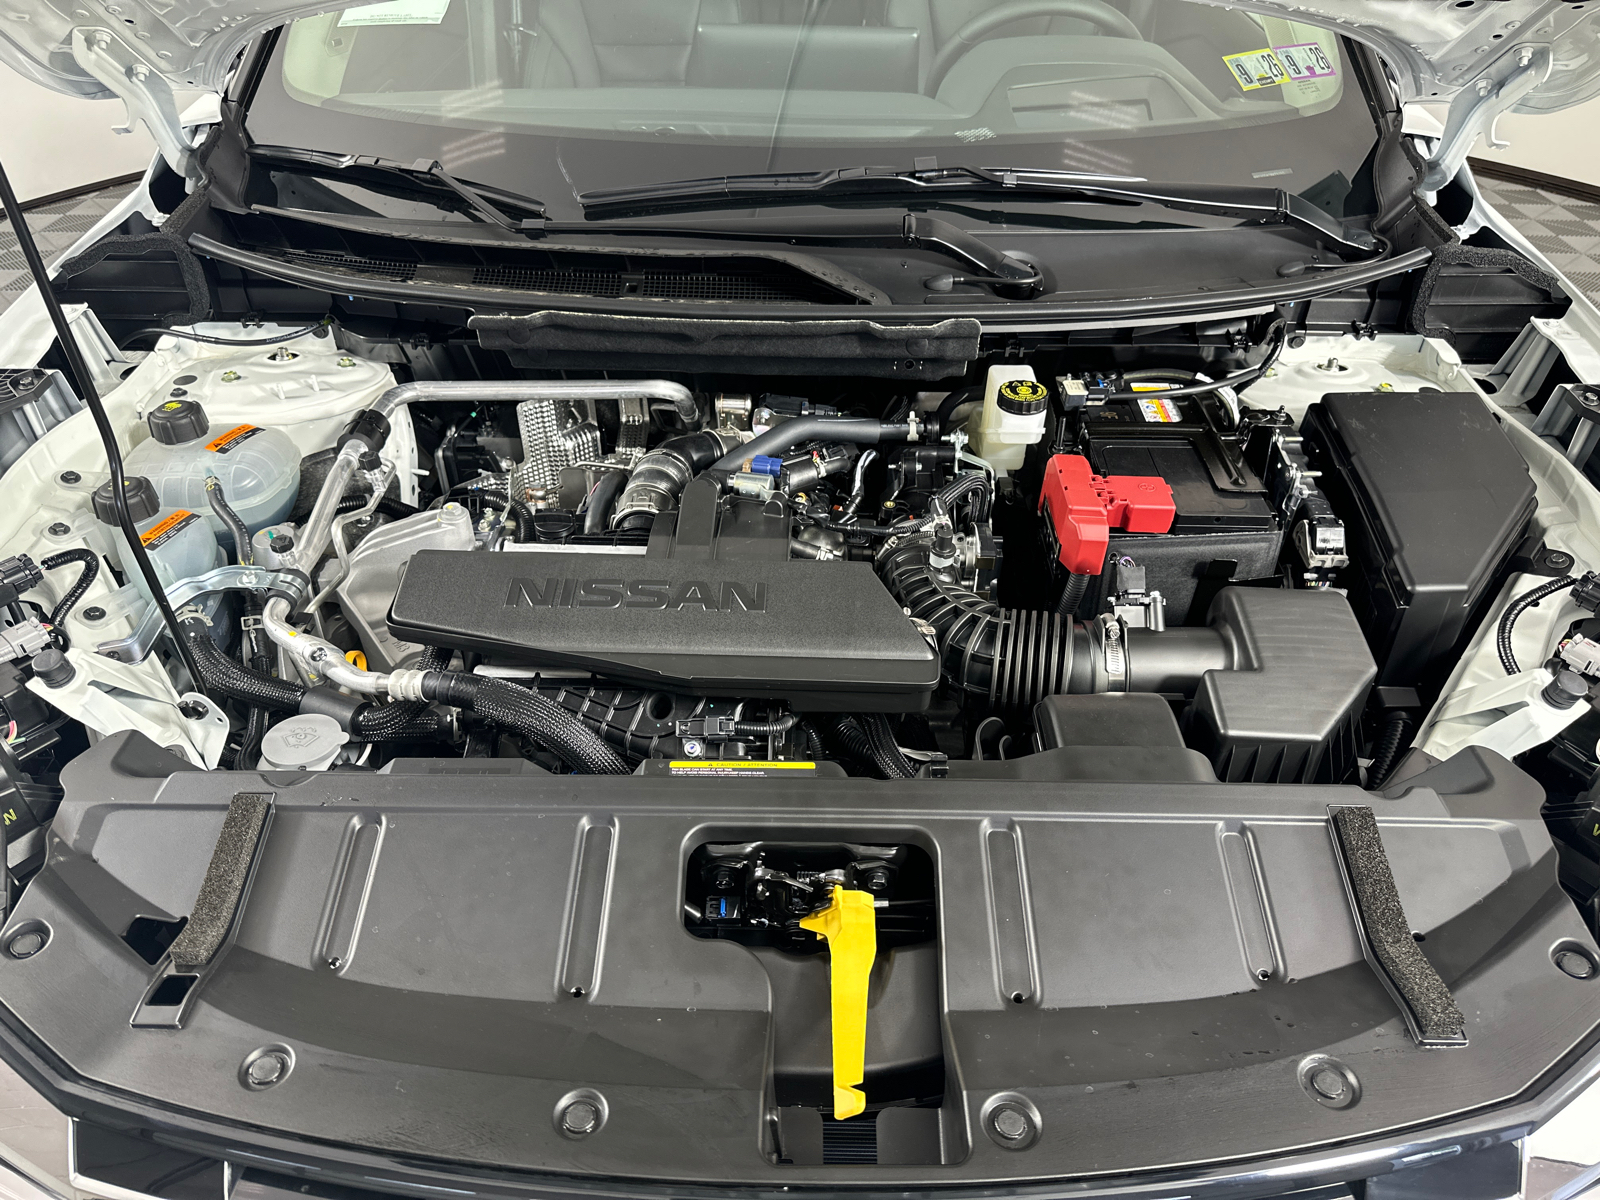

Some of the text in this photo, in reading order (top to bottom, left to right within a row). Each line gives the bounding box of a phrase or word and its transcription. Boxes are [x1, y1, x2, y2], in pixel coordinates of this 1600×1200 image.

[1235, 63, 1253, 84] 9
[1261, 53, 1285, 78] 26
[1285, 54, 1302, 75] 9
[1308, 46, 1331, 70] 26
[503, 577, 768, 613] NISSAN
